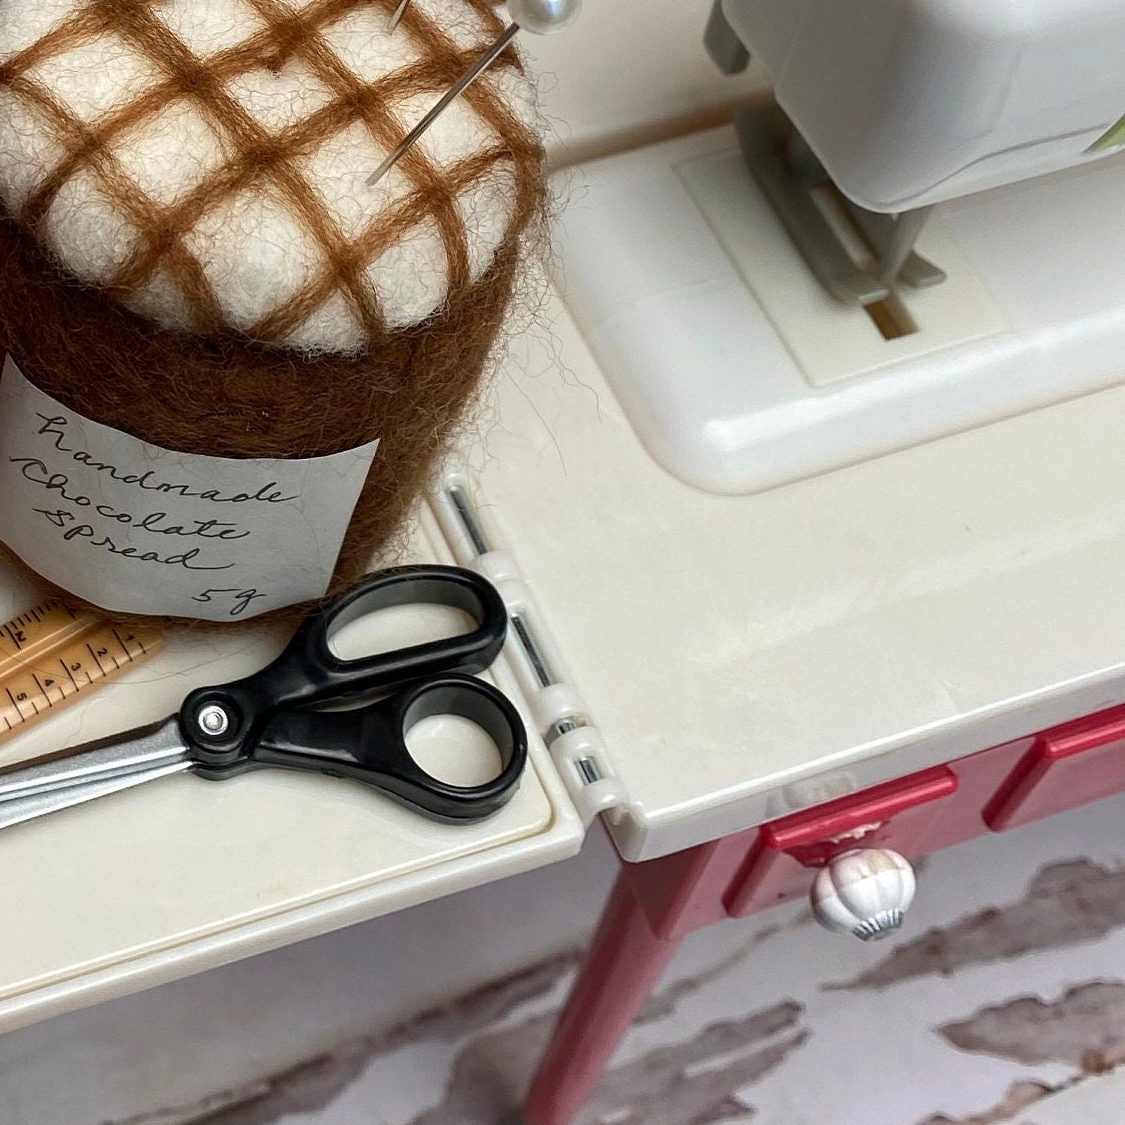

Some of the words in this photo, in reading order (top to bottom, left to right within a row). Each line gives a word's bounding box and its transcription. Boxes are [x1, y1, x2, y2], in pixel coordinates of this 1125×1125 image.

[36, 412, 299, 503] handmade
[9, 456, 251, 539] Chocolate
[14, 630, 27, 643] 2
[125, 634, 135, 642] 1
[96, 647, 108, 658] 2
[70, 662, 82, 672] 3
[44, 678, 55, 688] 4
[16, 692, 28, 702] 5
